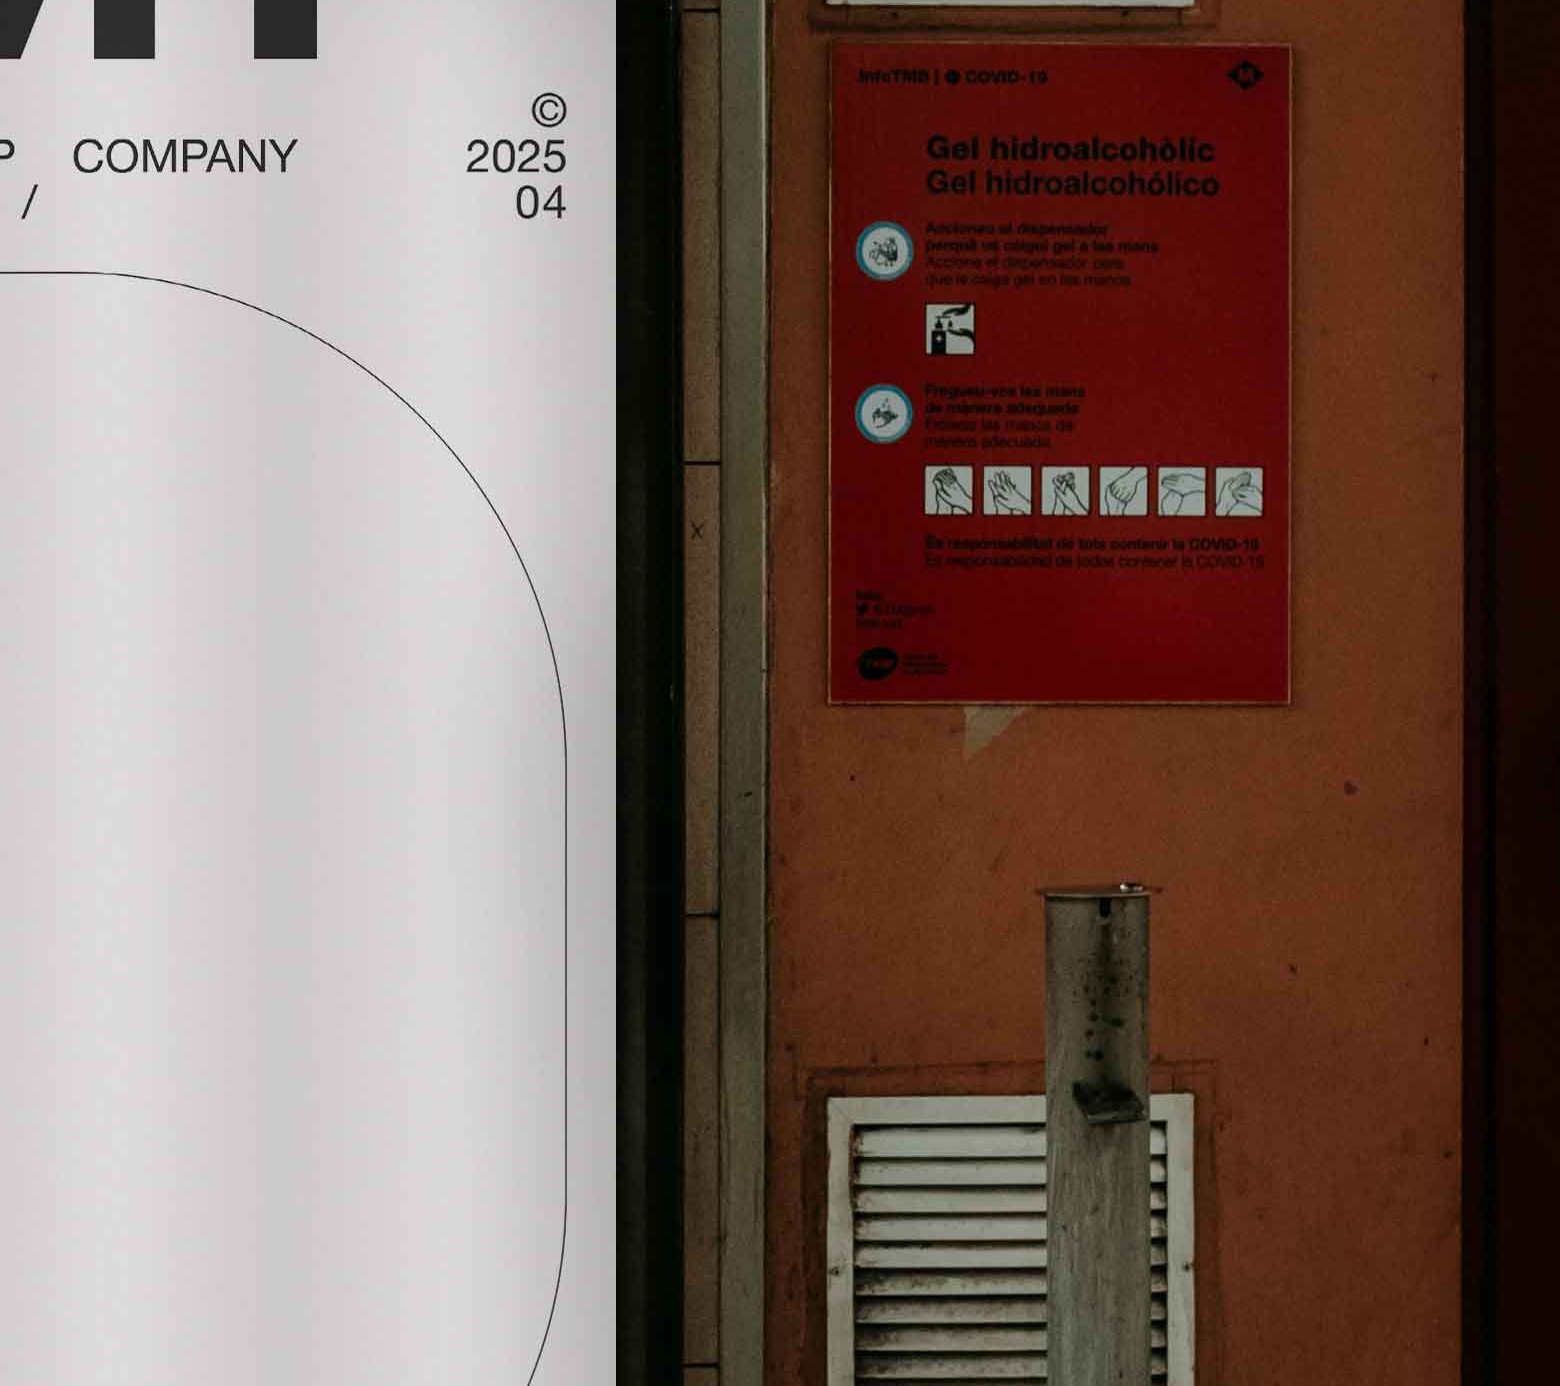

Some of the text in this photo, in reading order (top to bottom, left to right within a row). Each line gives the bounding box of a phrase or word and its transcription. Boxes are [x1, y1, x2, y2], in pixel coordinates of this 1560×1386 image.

[965, 69, 1048, 85] COVID-19
[73, 138, 299, 174] COMPANY
[466, 139, 567, 174] 2025
[927, 133, 1216, 163] Gel hidroalcohòlic
[927, 169, 1220, 198] Gel hidroalcohólico
[516, 184, 567, 220] 04
[1017, 221, 1109, 237] dispensador
[1053, 238, 1074, 254] gel
[1013, 273, 1034, 288] gel
[1189, 536, 1260, 550] COVID-19
